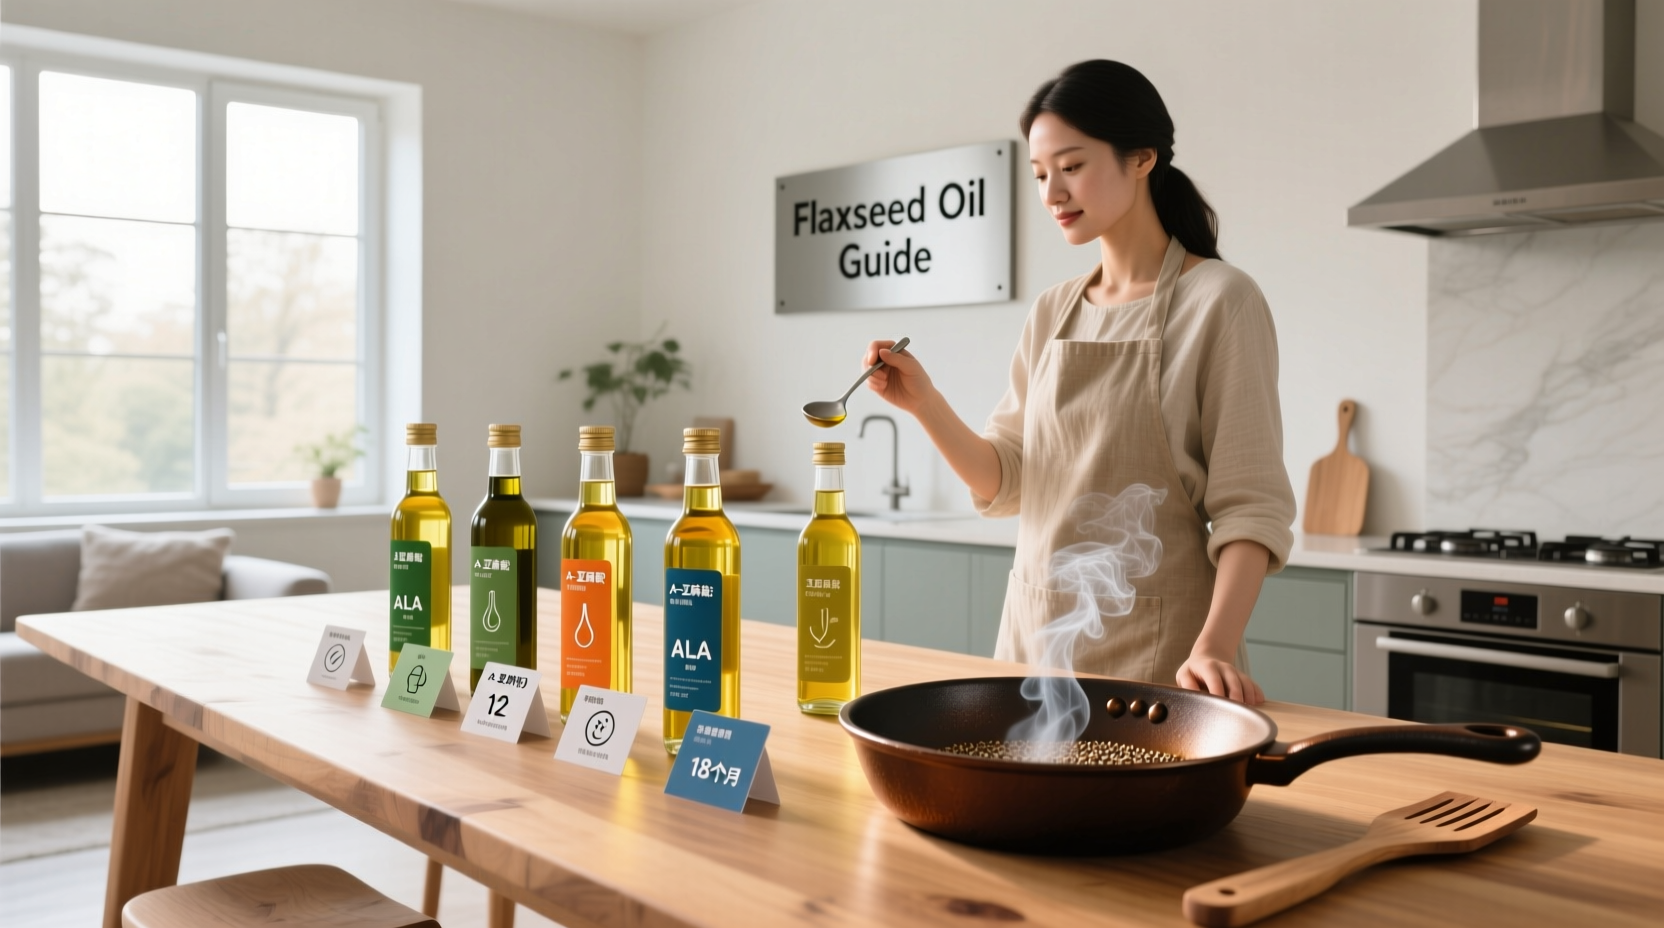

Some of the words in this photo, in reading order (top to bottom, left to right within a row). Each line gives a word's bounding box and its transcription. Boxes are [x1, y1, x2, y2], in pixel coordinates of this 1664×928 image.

[794, 186, 925, 236] Flaxseed
[939, 178, 985, 219] Oil
[839, 238, 931, 279] Guide
[393, 594, 423, 611] ALA
[671, 638, 712, 661] ALA
[487, 693, 509, 718] 12
[691, 757, 742, 788] 18个月
